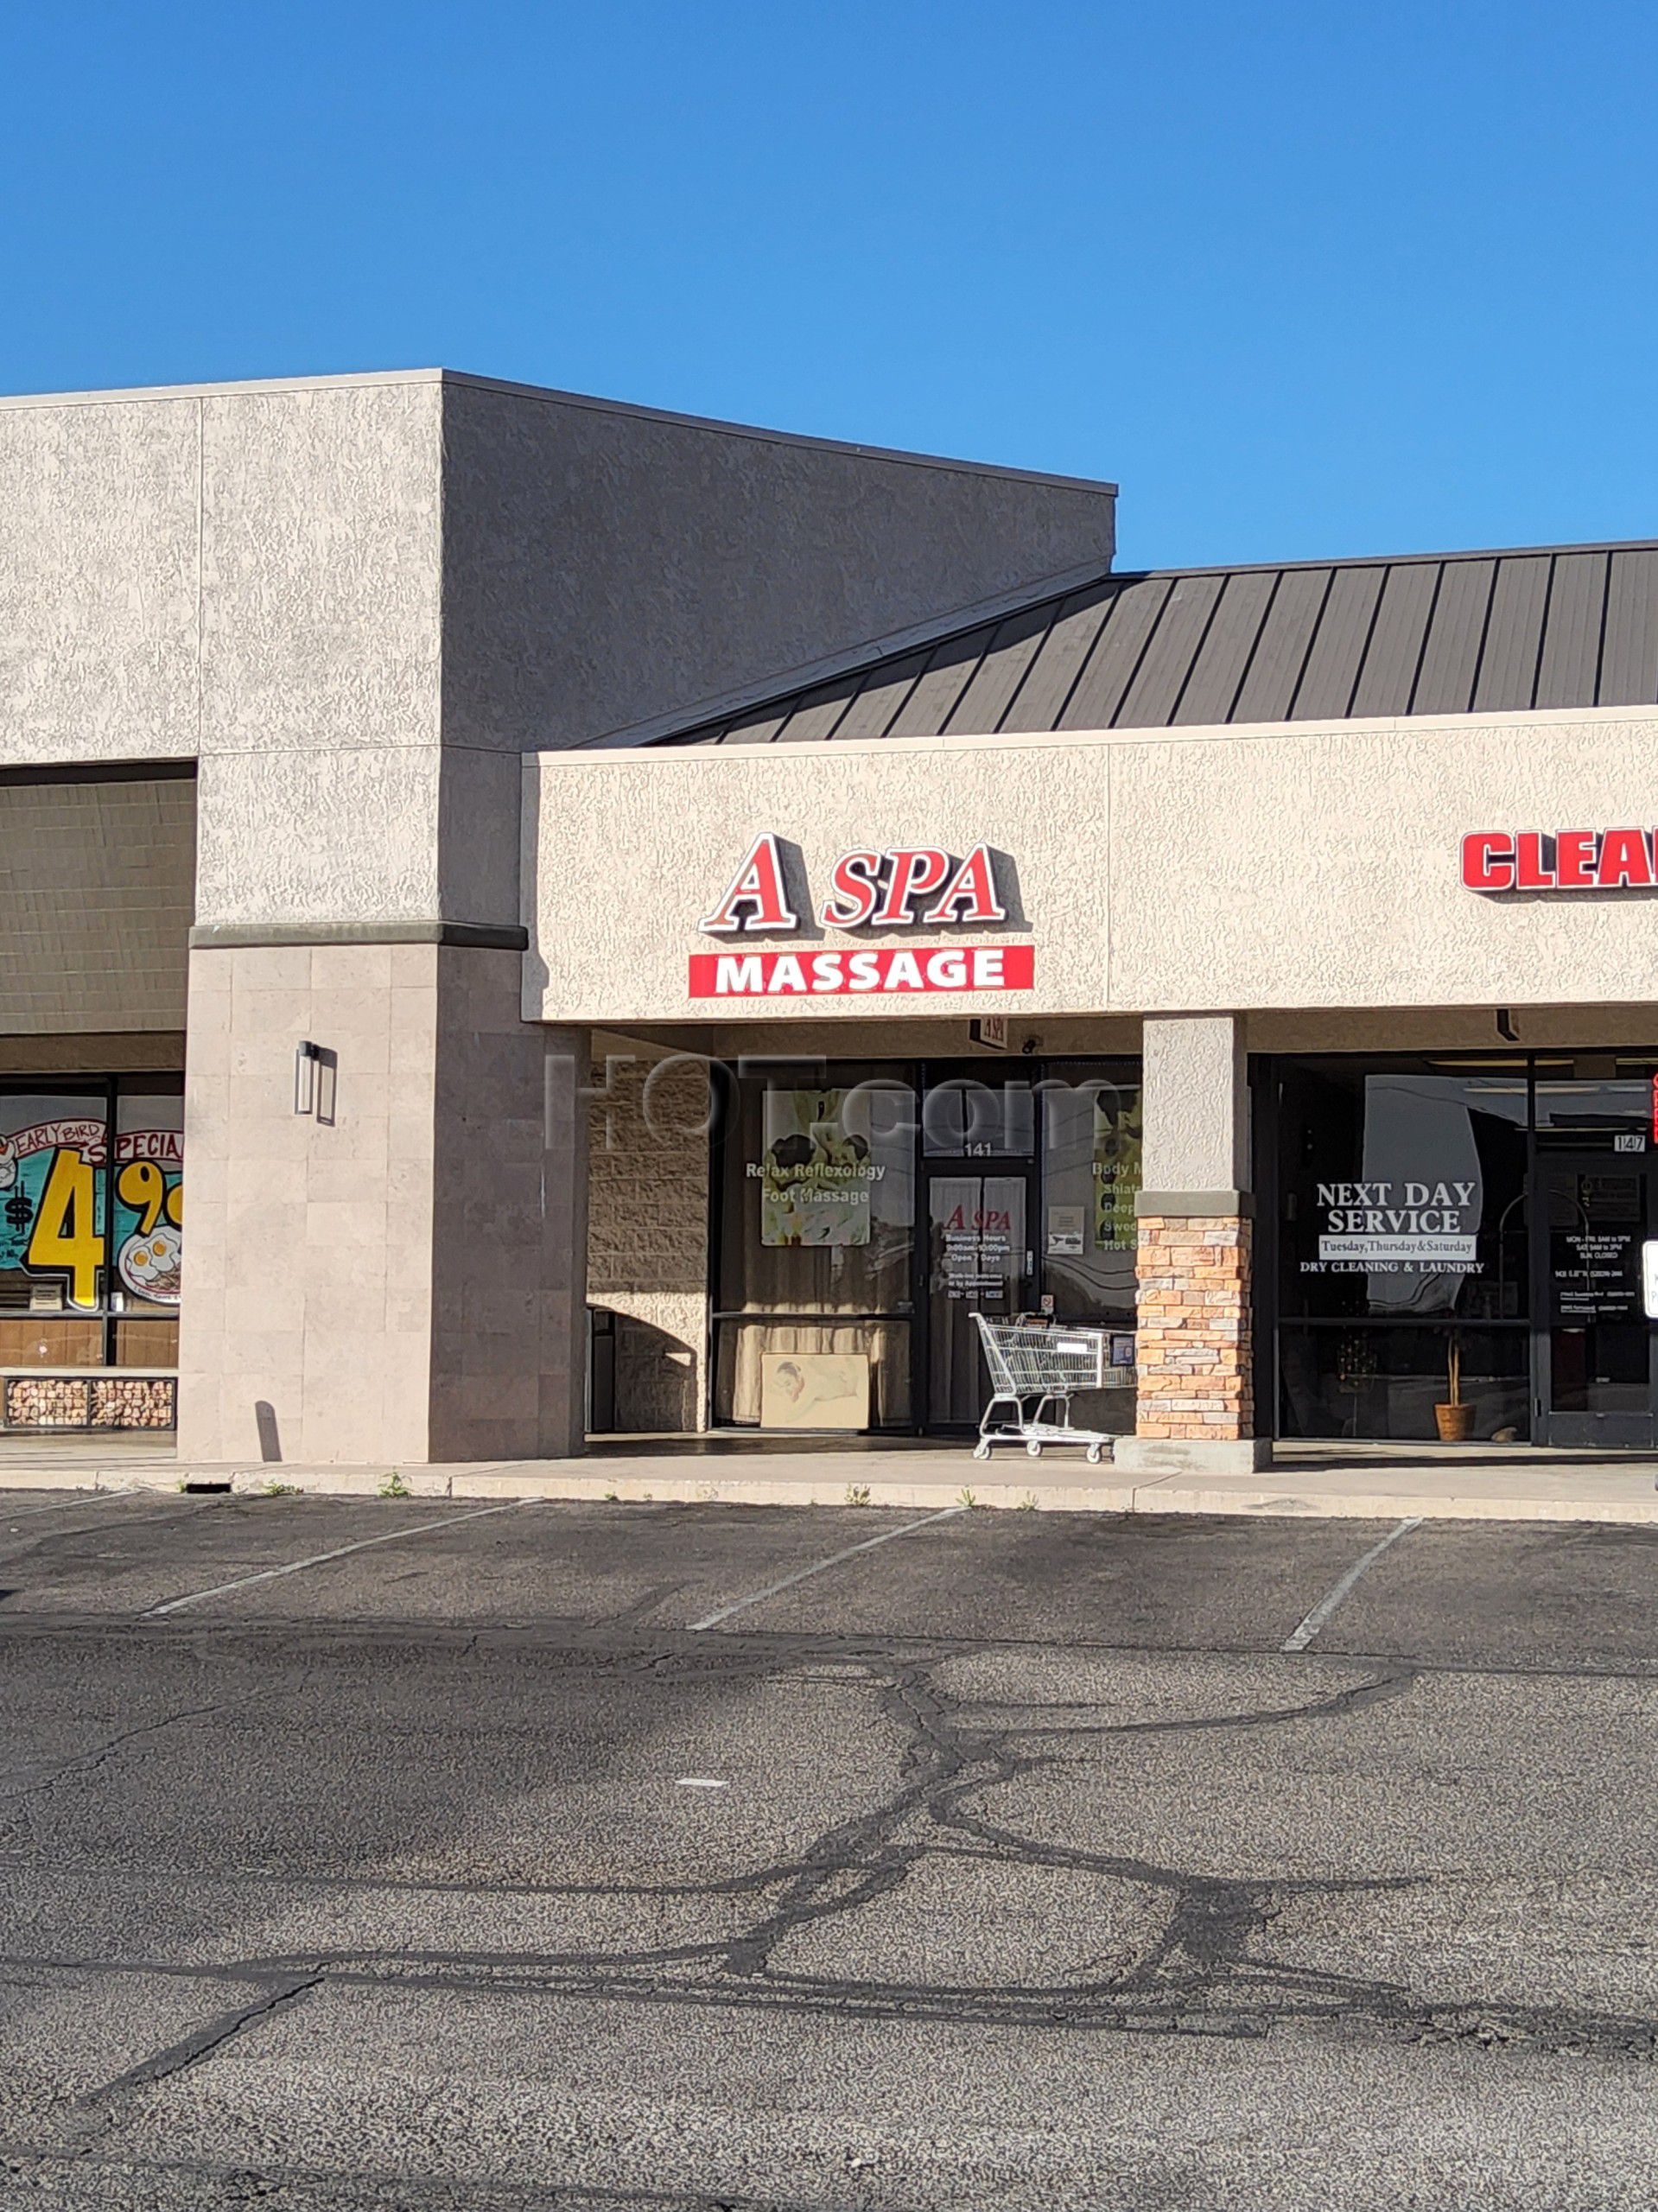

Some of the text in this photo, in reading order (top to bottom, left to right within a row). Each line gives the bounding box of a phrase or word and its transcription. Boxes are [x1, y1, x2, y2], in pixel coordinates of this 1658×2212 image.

[1460, 826, 1658, 891] CLEA
[698, 831, 1007, 933] A SPA
[715, 950, 1005, 994] MASSAGE
[16, 1123, 100, 1155] EARLY BIRD
[87, 1133, 185, 1163] SPECIA
[964, 1141, 992, 1157] 141
[1617, 1135, 1644, 1151] 147
[746, 1163, 886, 1181] Relax Reflexology
[1091, 1161, 1129, 1177] Body
[763, 1189, 871, 1205] Foot Massage
[1316, 1182, 1477, 1207] NEXT DAY
[943, 1204, 1012, 1230] A SPA
[1327, 1210, 1461, 1234] SERVICE
[1103, 1239, 1127, 1252] Hot
[1299, 1262, 1485, 1274] DRY CLEANING & LAUNDRY
